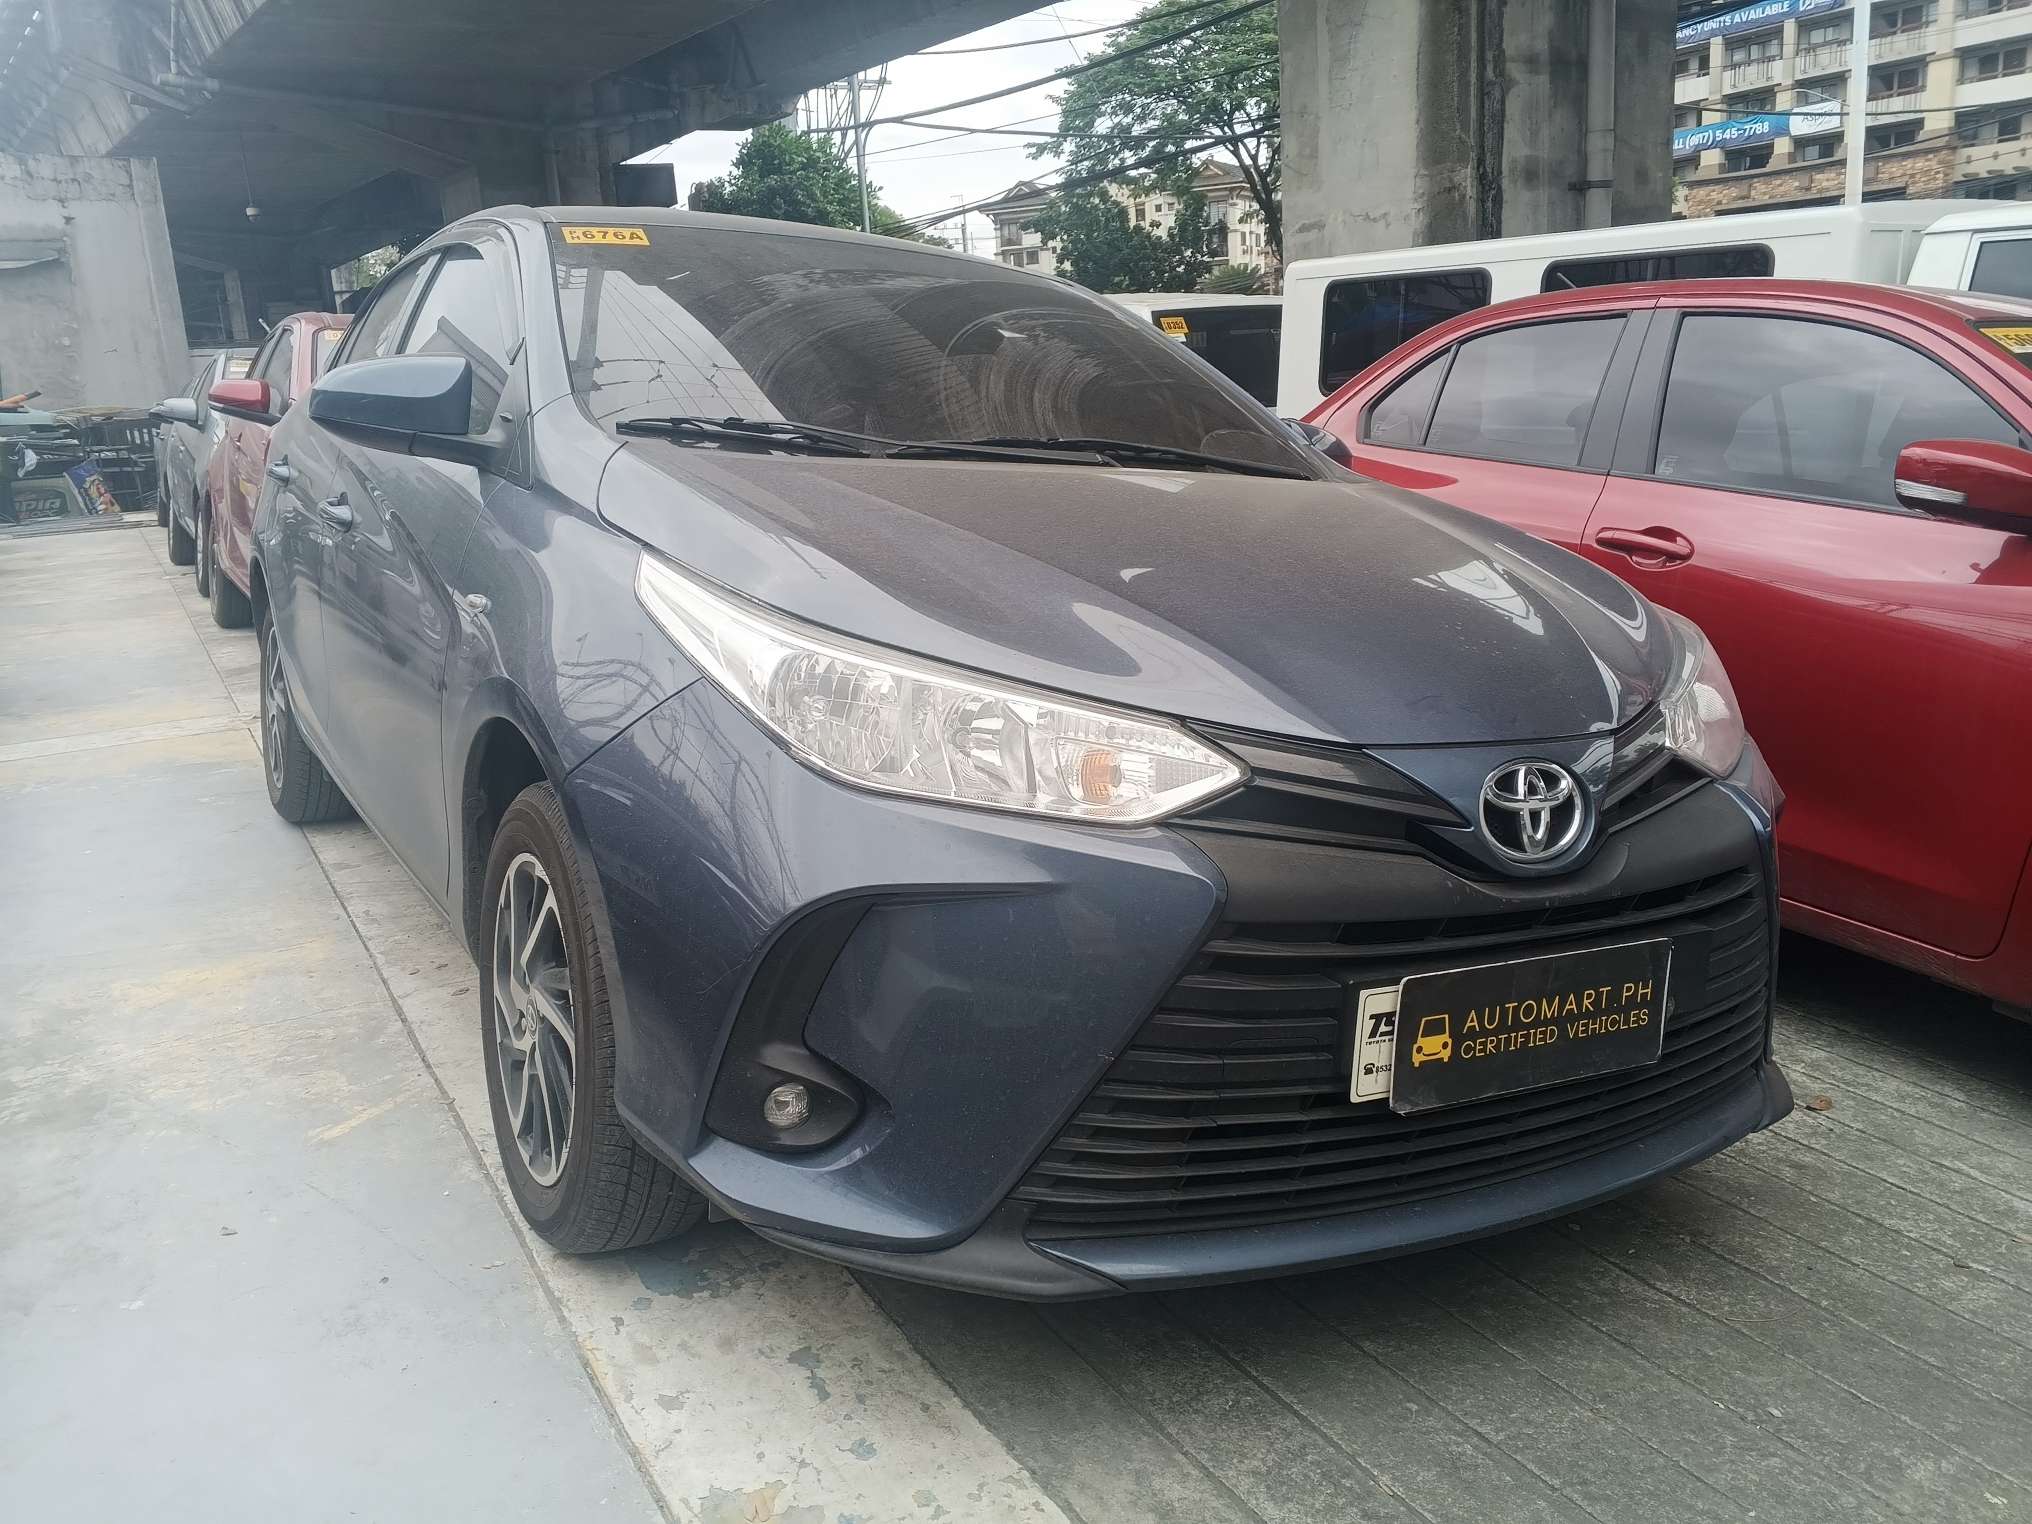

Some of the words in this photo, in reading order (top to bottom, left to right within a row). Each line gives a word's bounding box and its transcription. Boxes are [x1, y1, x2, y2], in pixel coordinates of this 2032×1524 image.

[1703, 16, 1732, 31] UNITS
[1733, 1, 1790, 25] AVAILABLE
[1715, 122, 1770, 141] 545-7788
[1463, 980, 1652, 1034] AUTOMART.PH
[1461, 1025, 1558, 1059] CERTIFIED
[1567, 1009, 1649, 1039] VEHICLES
